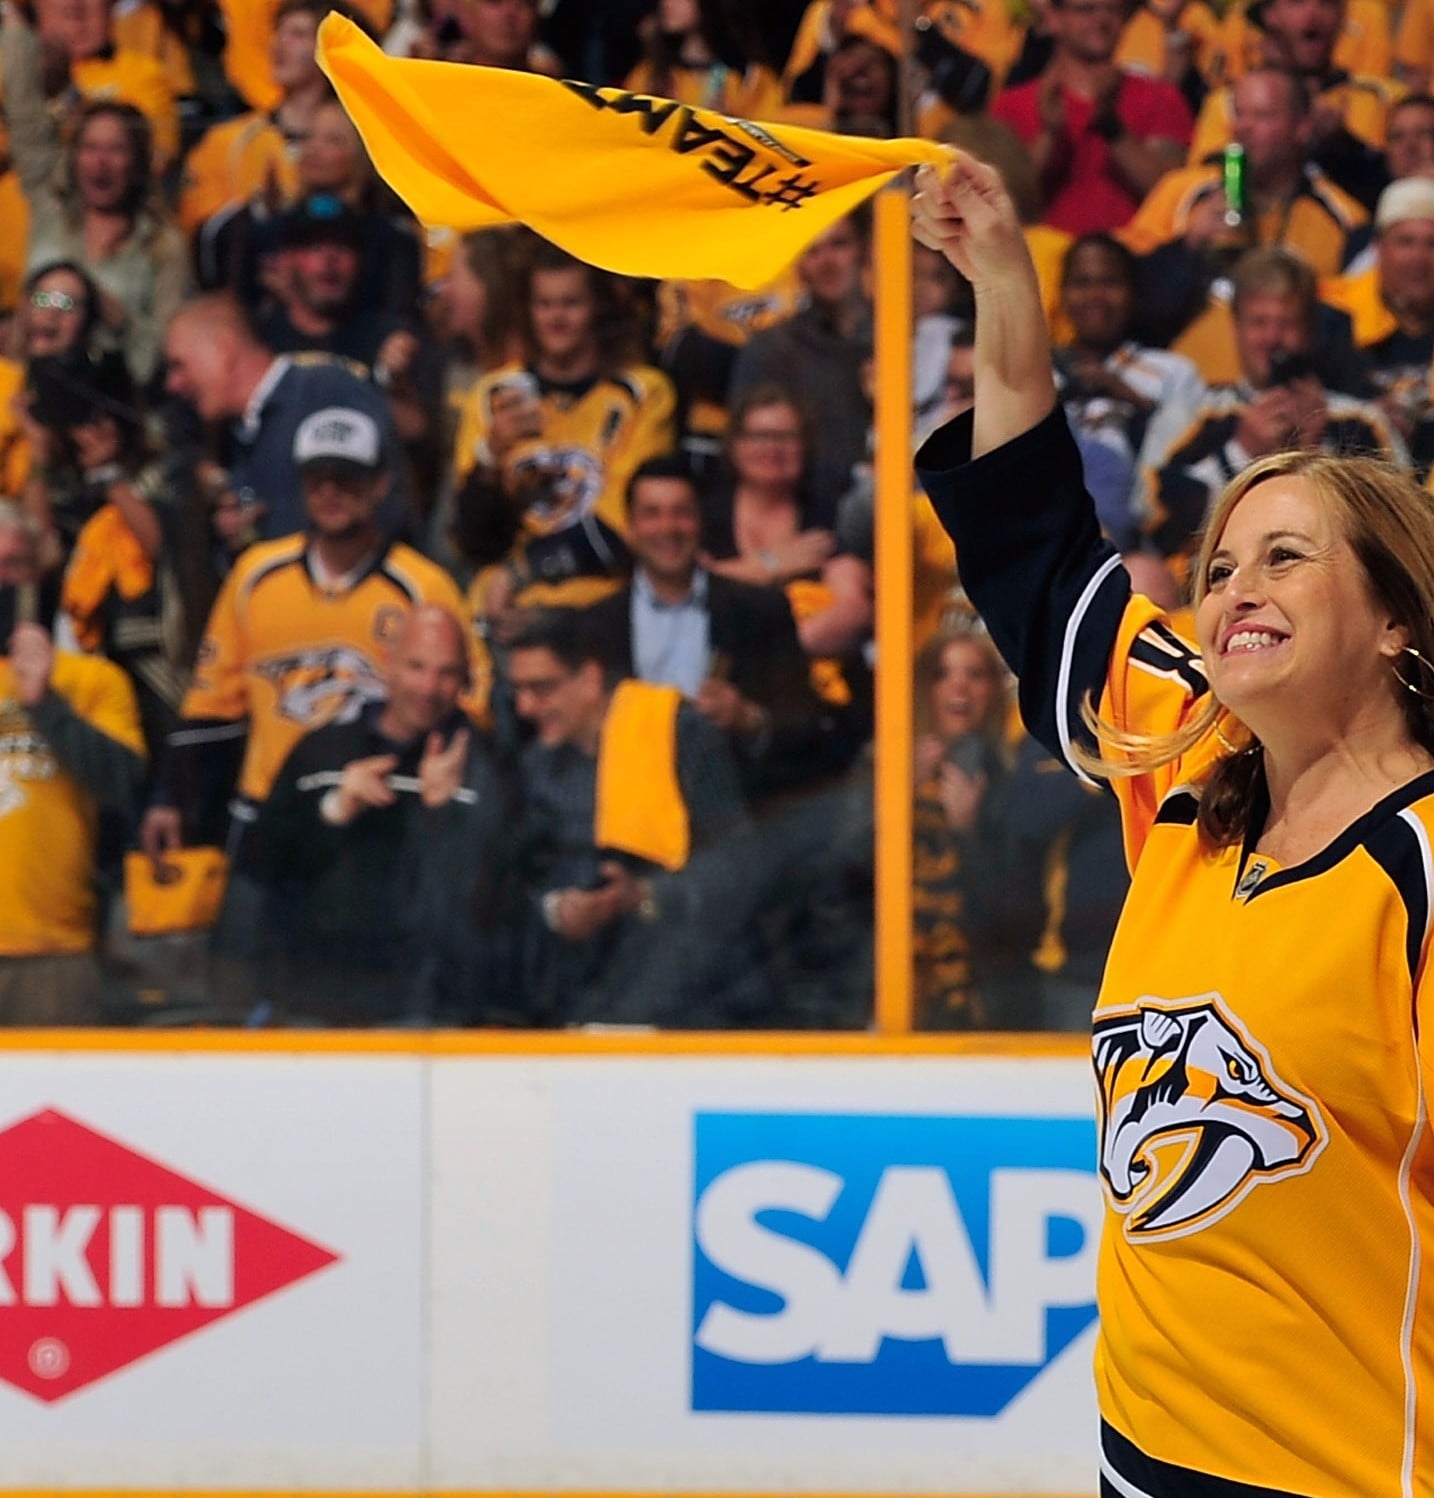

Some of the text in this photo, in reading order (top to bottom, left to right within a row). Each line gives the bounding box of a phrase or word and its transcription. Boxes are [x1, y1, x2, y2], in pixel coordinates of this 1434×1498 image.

[561, 80, 819, 212] #TEAM
[0, 1204, 235, 1308] KIN
[696, 1159, 1098, 1367] SAP
